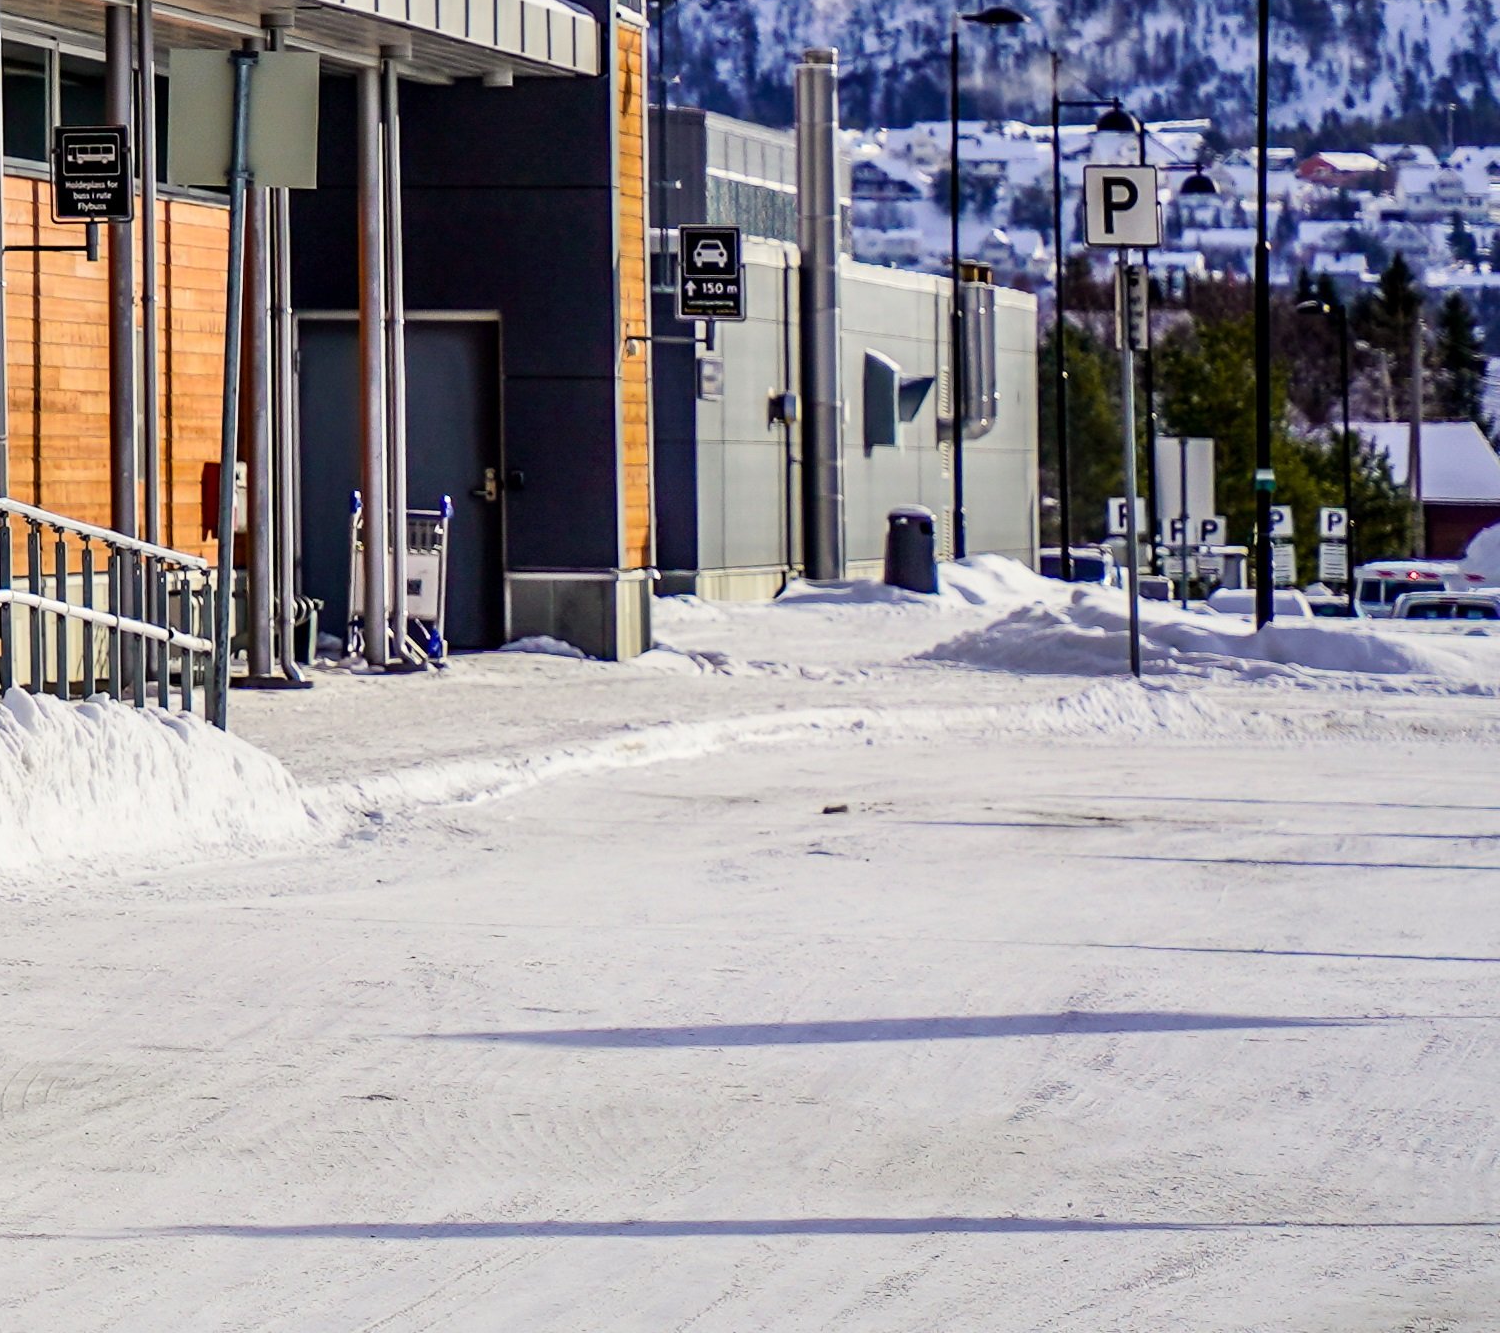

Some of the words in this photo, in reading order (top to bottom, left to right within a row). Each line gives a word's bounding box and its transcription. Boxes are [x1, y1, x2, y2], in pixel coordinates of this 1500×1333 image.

[65, 180, 106, 190] Holdeplass
[107, 180, 119, 189] for
[73, 192, 90, 200] buss
[96, 192, 112, 200] rute
[77, 202, 107, 212] Flybuss
[1102, 176, 1139, 234] P
[702, 282, 724, 294] 150
[726, 285, 738, 294] m
[1327, 512, 1342, 531] P
[1202, 519, 1218, 541] P
